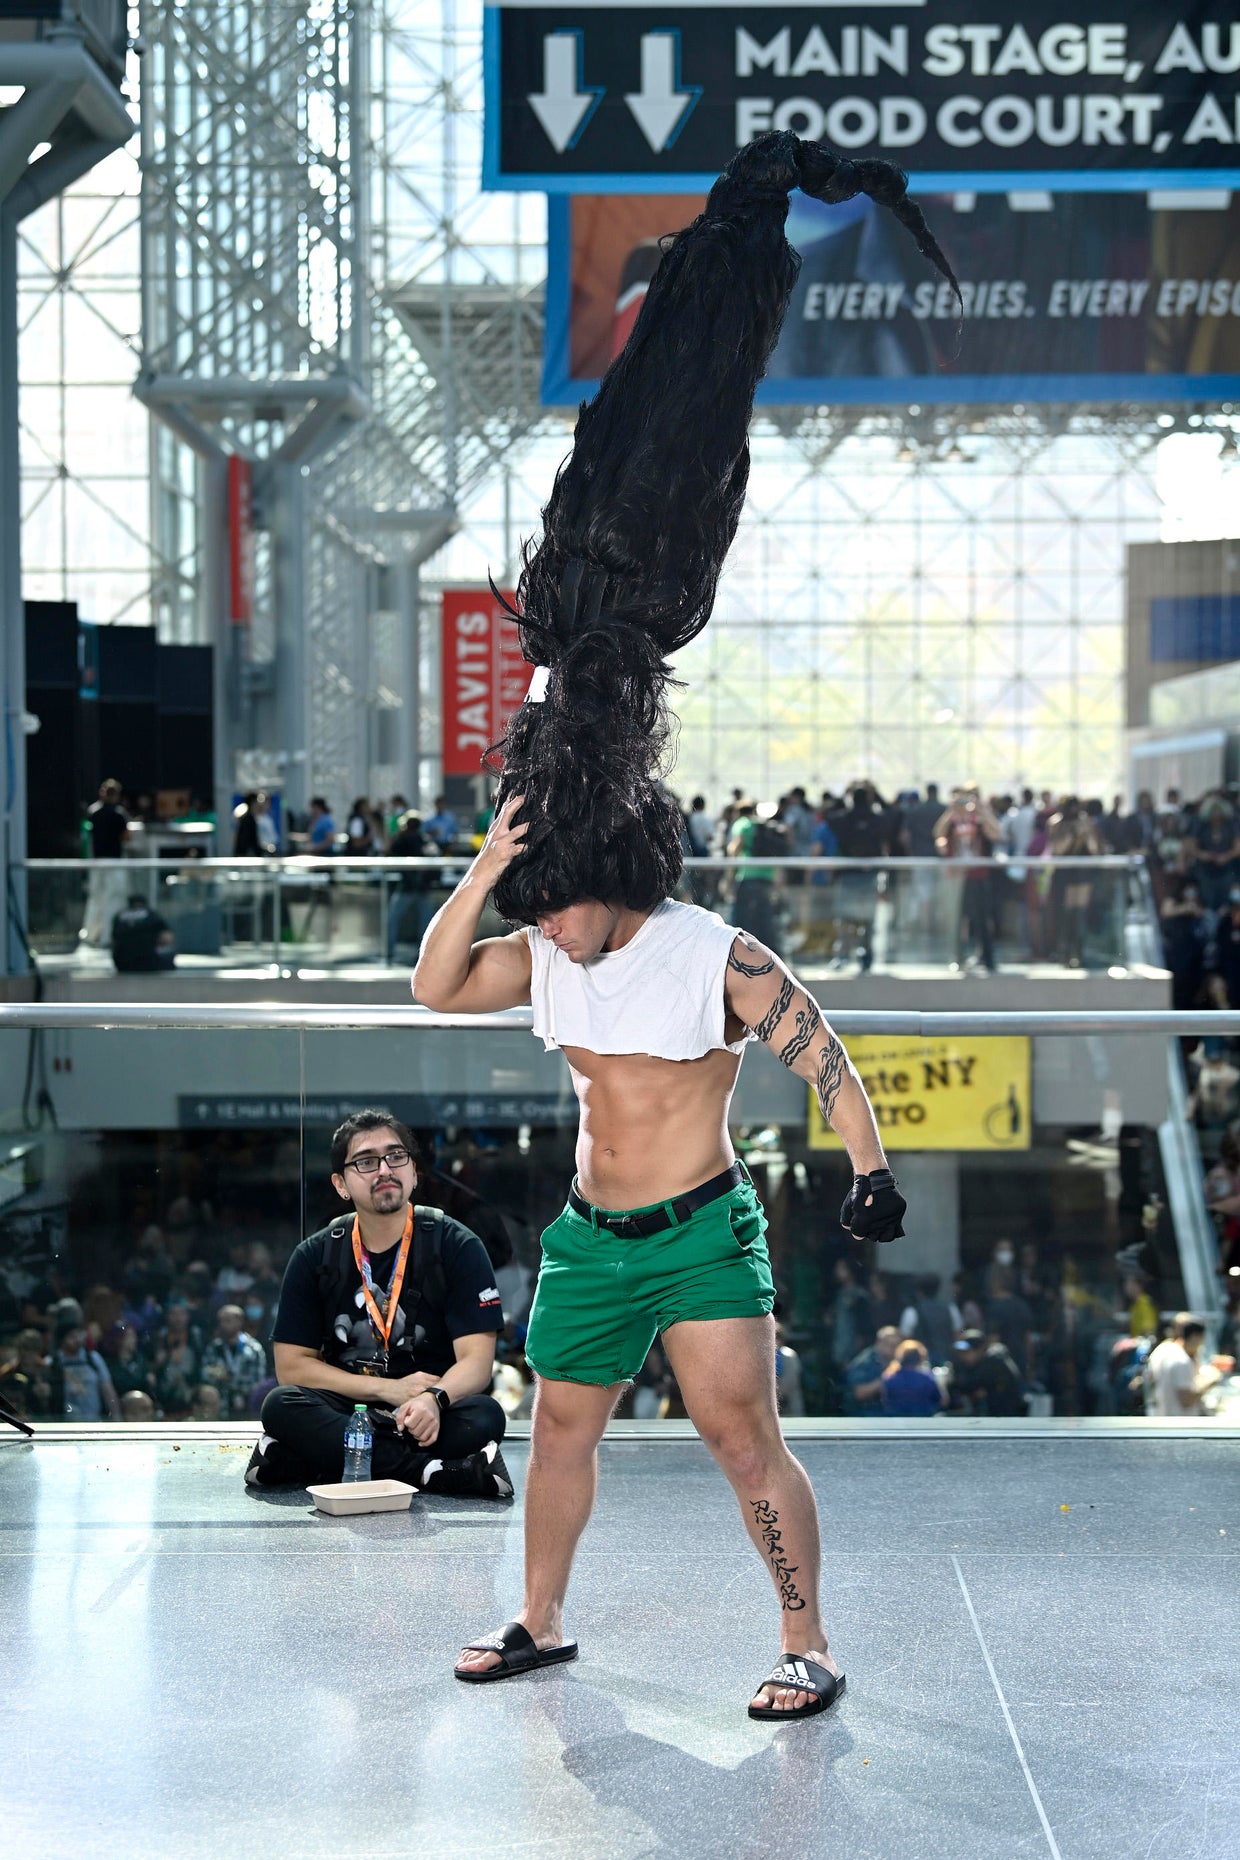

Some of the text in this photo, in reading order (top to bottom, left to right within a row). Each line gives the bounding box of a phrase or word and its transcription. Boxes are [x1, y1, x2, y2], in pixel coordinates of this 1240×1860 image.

[735, 24, 909, 77] MAIN
[922, 23, 1144, 83] STAGE,
[735, 92, 1240, 153] FOOD COURT, A
[803, 281, 905, 321] EVERY
[911, 280, 1036, 321] SERIES.
[1047, 278, 1150, 318] EVERY
[456, 611, 490, 750] JAVITS
[921, 1056, 977, 1090] NY
